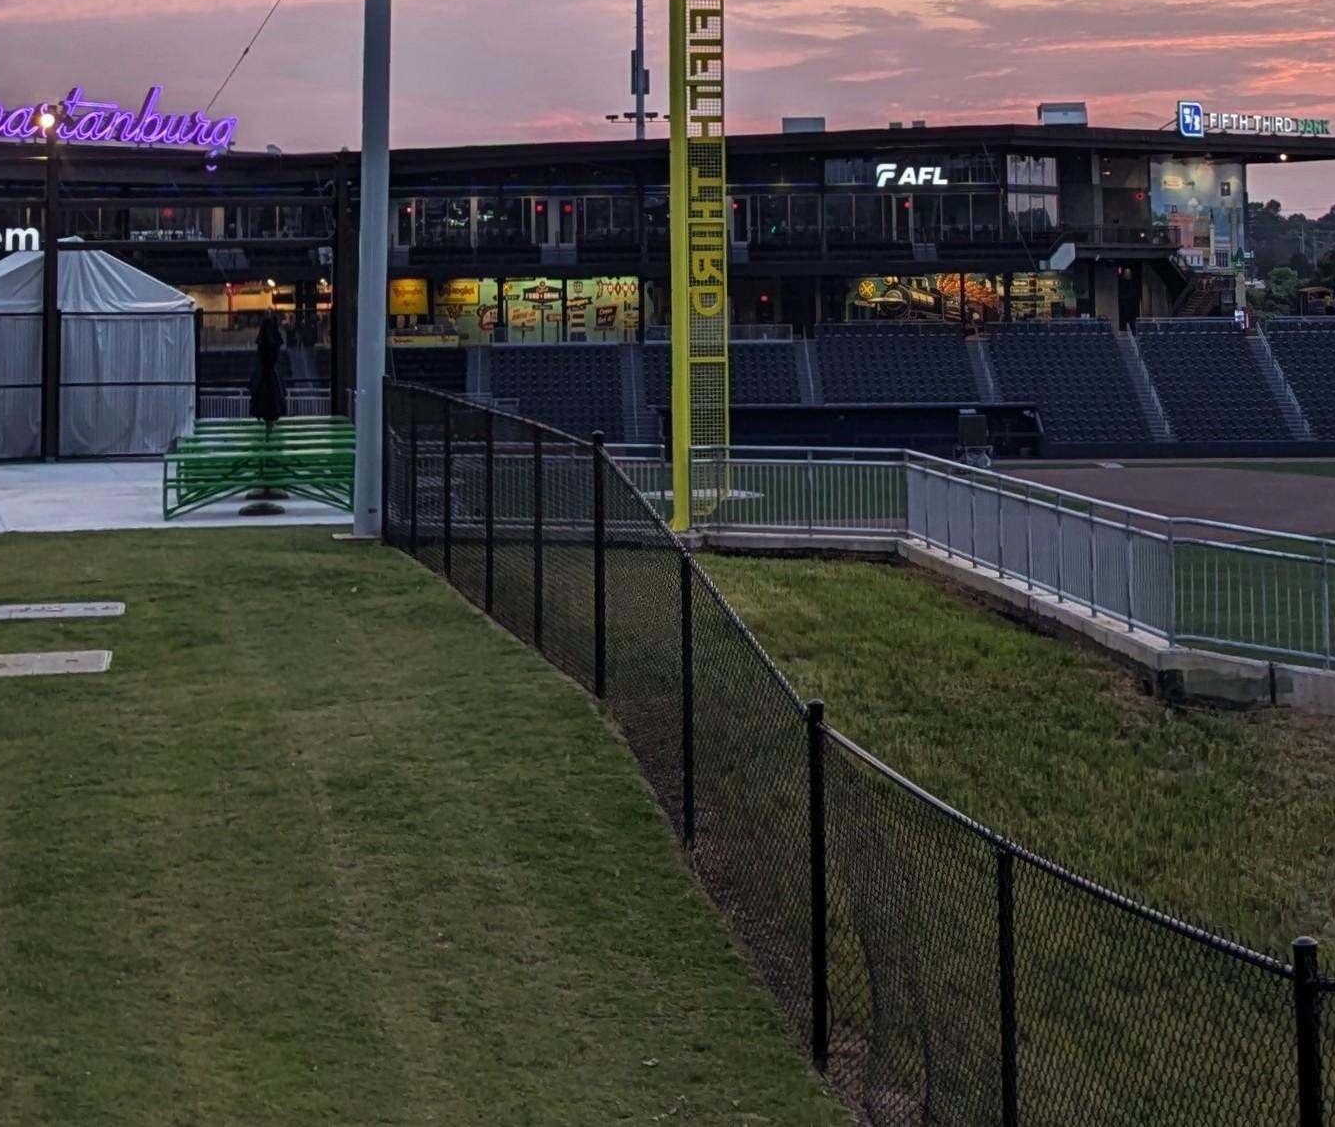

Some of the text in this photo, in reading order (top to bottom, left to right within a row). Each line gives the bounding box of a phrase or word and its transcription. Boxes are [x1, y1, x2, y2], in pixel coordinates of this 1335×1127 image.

[1209, 112, 1249, 131] FIFTH
[1253, 115, 1294, 133] THIRD
[897, 166, 949, 185] AFL
